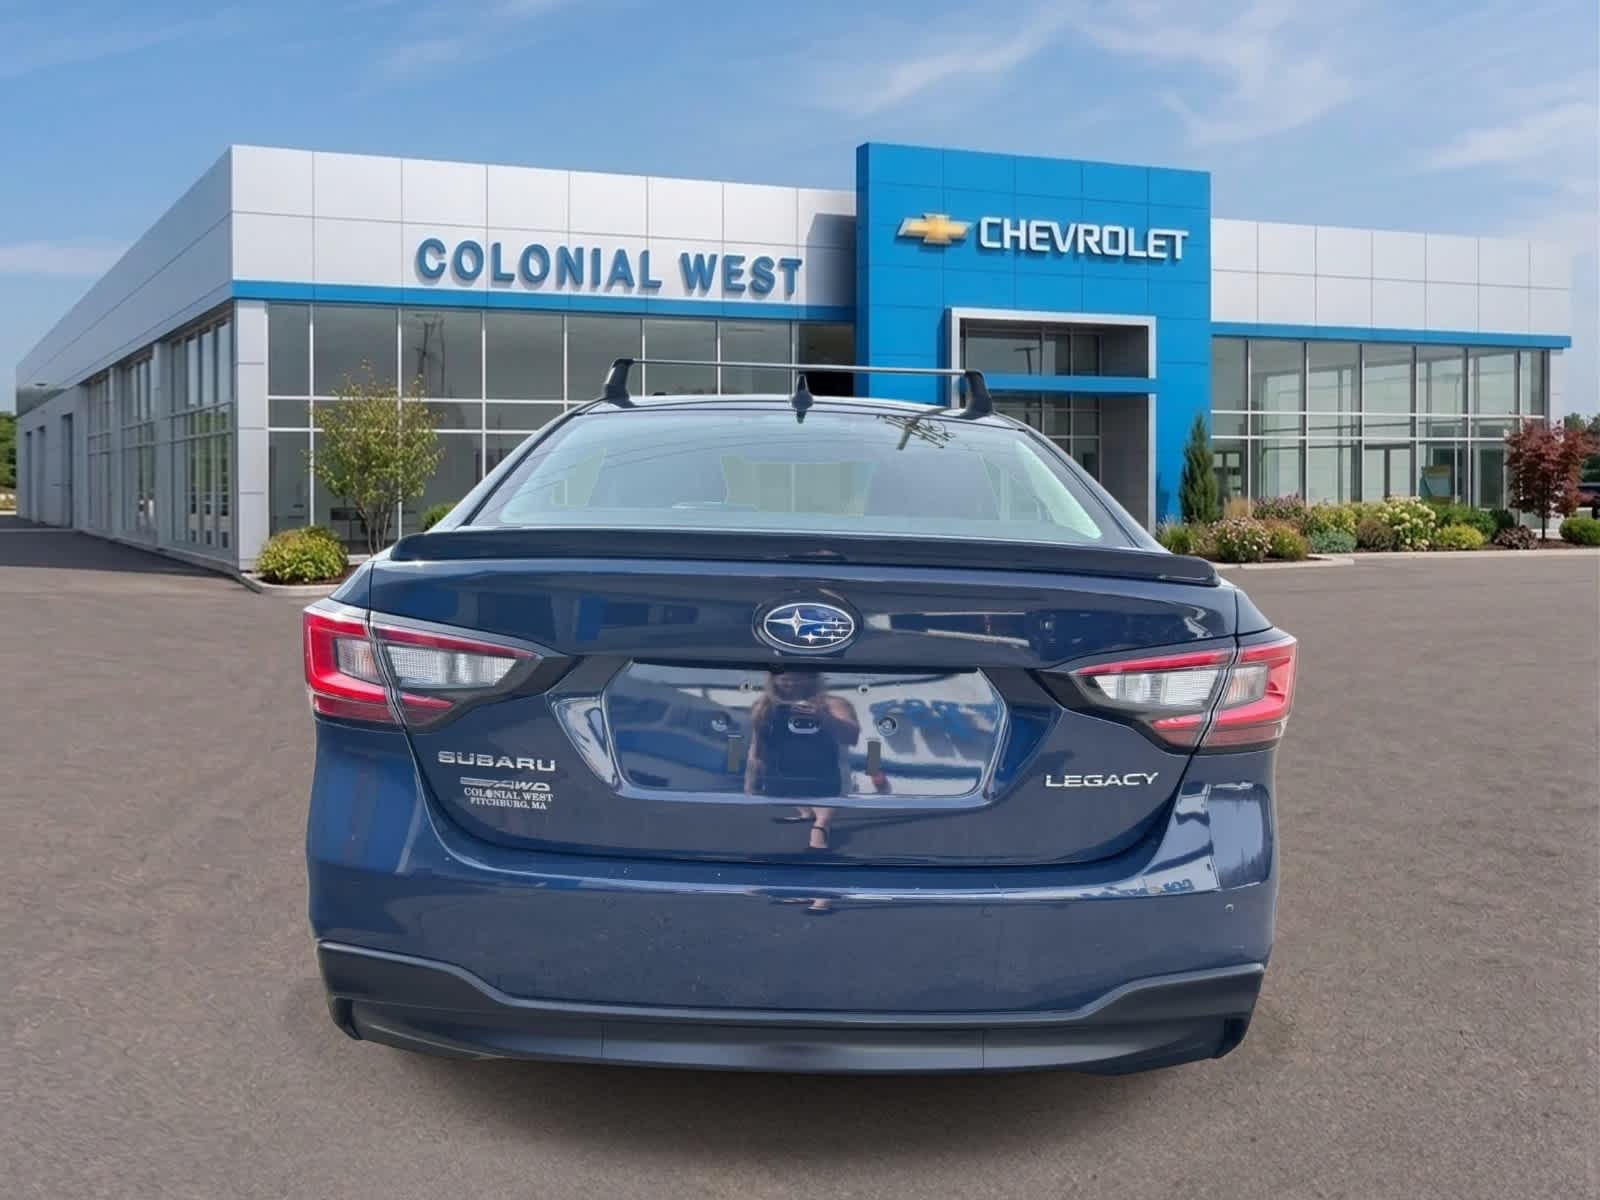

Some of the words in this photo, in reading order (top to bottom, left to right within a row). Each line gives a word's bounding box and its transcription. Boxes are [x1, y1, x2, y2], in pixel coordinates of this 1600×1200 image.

[980, 216, 1189, 261] CHEVROLET
[416, 238, 663, 290] COLONIAL
[680, 251, 803, 297] WEST
[438, 751, 556, 772] SUBARU
[1045, 772, 1159, 788] LEGACY
[464, 787, 521, 800] COLONIAL
[522, 792, 554, 802] WEST
[531, 801, 547, 810] MA
